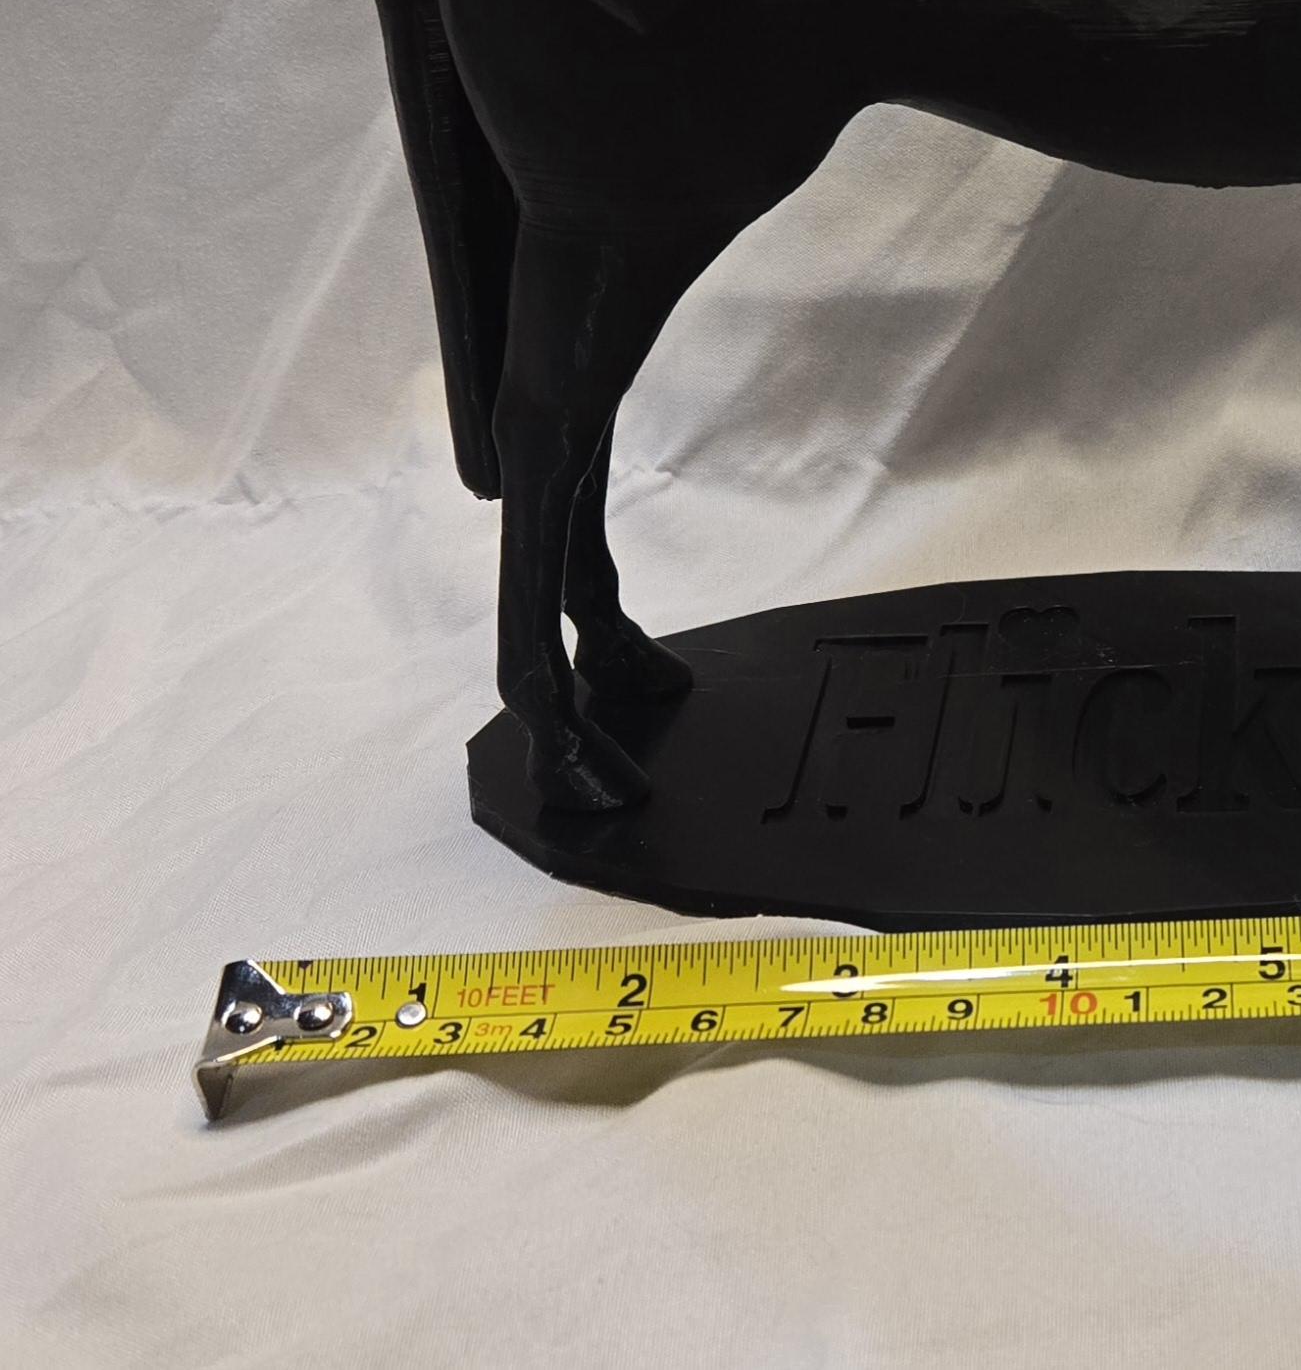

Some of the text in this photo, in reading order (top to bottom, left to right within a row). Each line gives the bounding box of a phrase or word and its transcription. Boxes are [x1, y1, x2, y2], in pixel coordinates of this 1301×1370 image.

[618, 974, 646, 1008] 2
[1046, 955, 1071, 988] 4
[1259, 947, 1286, 980] 5
[344, 1022, 374, 1048] 2
[433, 1022, 461, 1045] 3
[474, 1020, 513, 1038] 3m
[518, 1018, 548, 1039] 4
[604, 1013, 635, 1036] 5
[690, 1010, 719, 1031] 6
[778, 1006, 804, 1028] 7
[862, 1002, 889, 1024] 8
[948, 998, 973, 1020] 9
[1124, 991, 1141, 1013] 1
[1203, 988, 1228, 1010] 2
